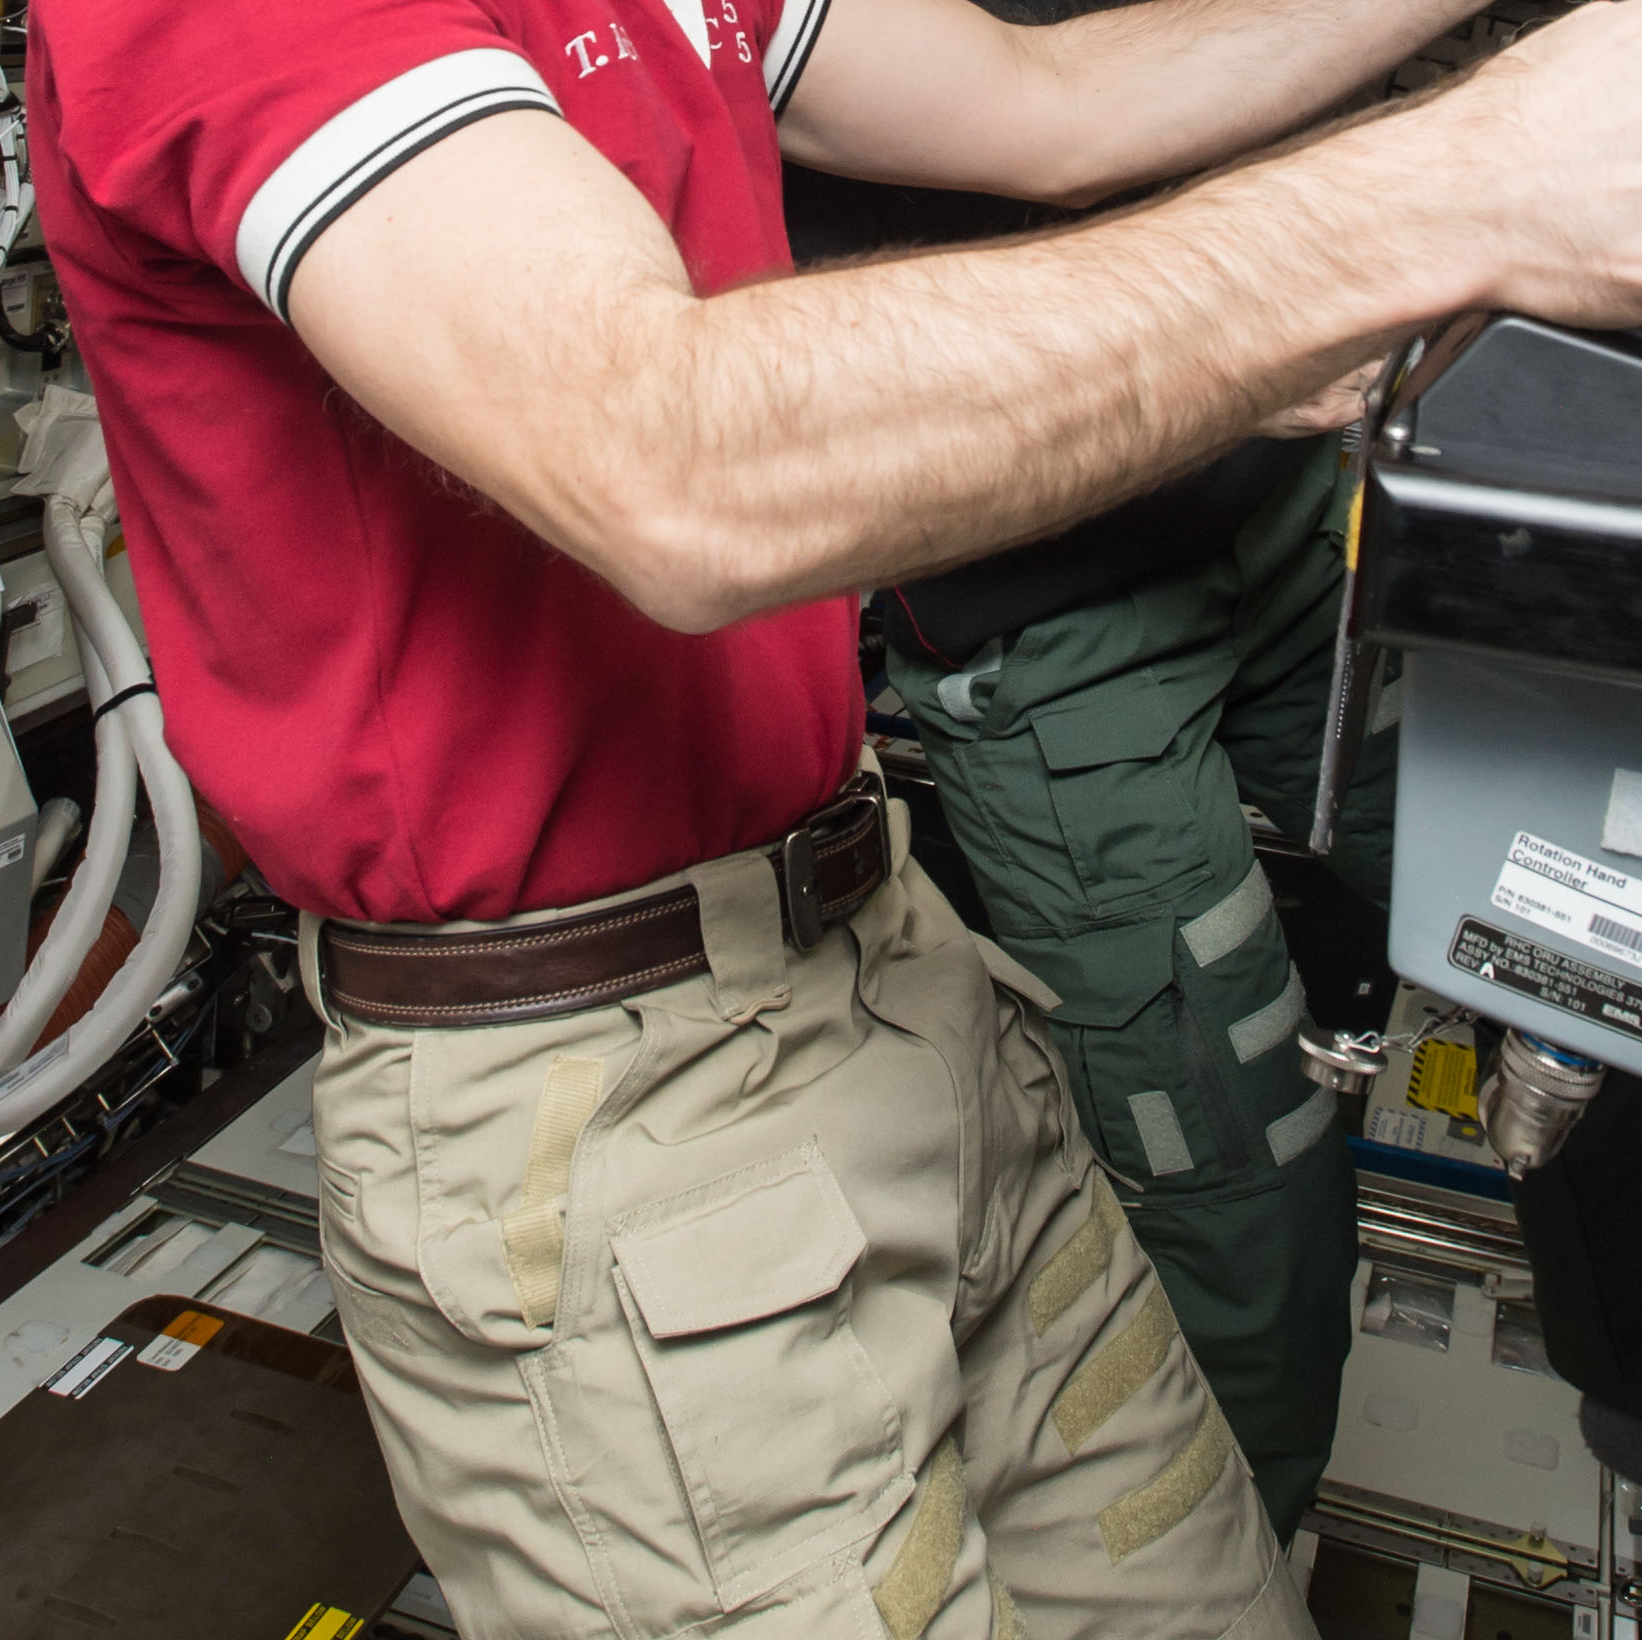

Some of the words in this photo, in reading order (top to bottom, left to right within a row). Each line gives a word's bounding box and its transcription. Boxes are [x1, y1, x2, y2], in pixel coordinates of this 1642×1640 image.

[736, 32, 753, 65] 5
[1510, 848, 1590, 891] Controller
[1516, 833, 1583, 871] Rotation
[1585, 863, 1627, 890] Hand
[1497, 884, 1516, 899] P/N
[1493, 894, 1513, 908] S/N
[1513, 902, 1532, 916] 101
[1457, 940, 1490, 961] ASSY
[1460, 929, 1490, 950] MFD
[1488, 941, 1505, 957] by
[1504, 947, 1534, 967] EMS
[1533, 959, 1626, 1002] TECHNOLOGIES
[1478, 961, 1498, 980] A
[1503, 935, 1532, 954] RHC
[1531, 946, 1562, 966] ORU
[1560, 958, 1626, 991] ASSEMBLY
[1565, 996, 1587, 1013] 101
[1601, 1003, 1642, 1027] EMS
